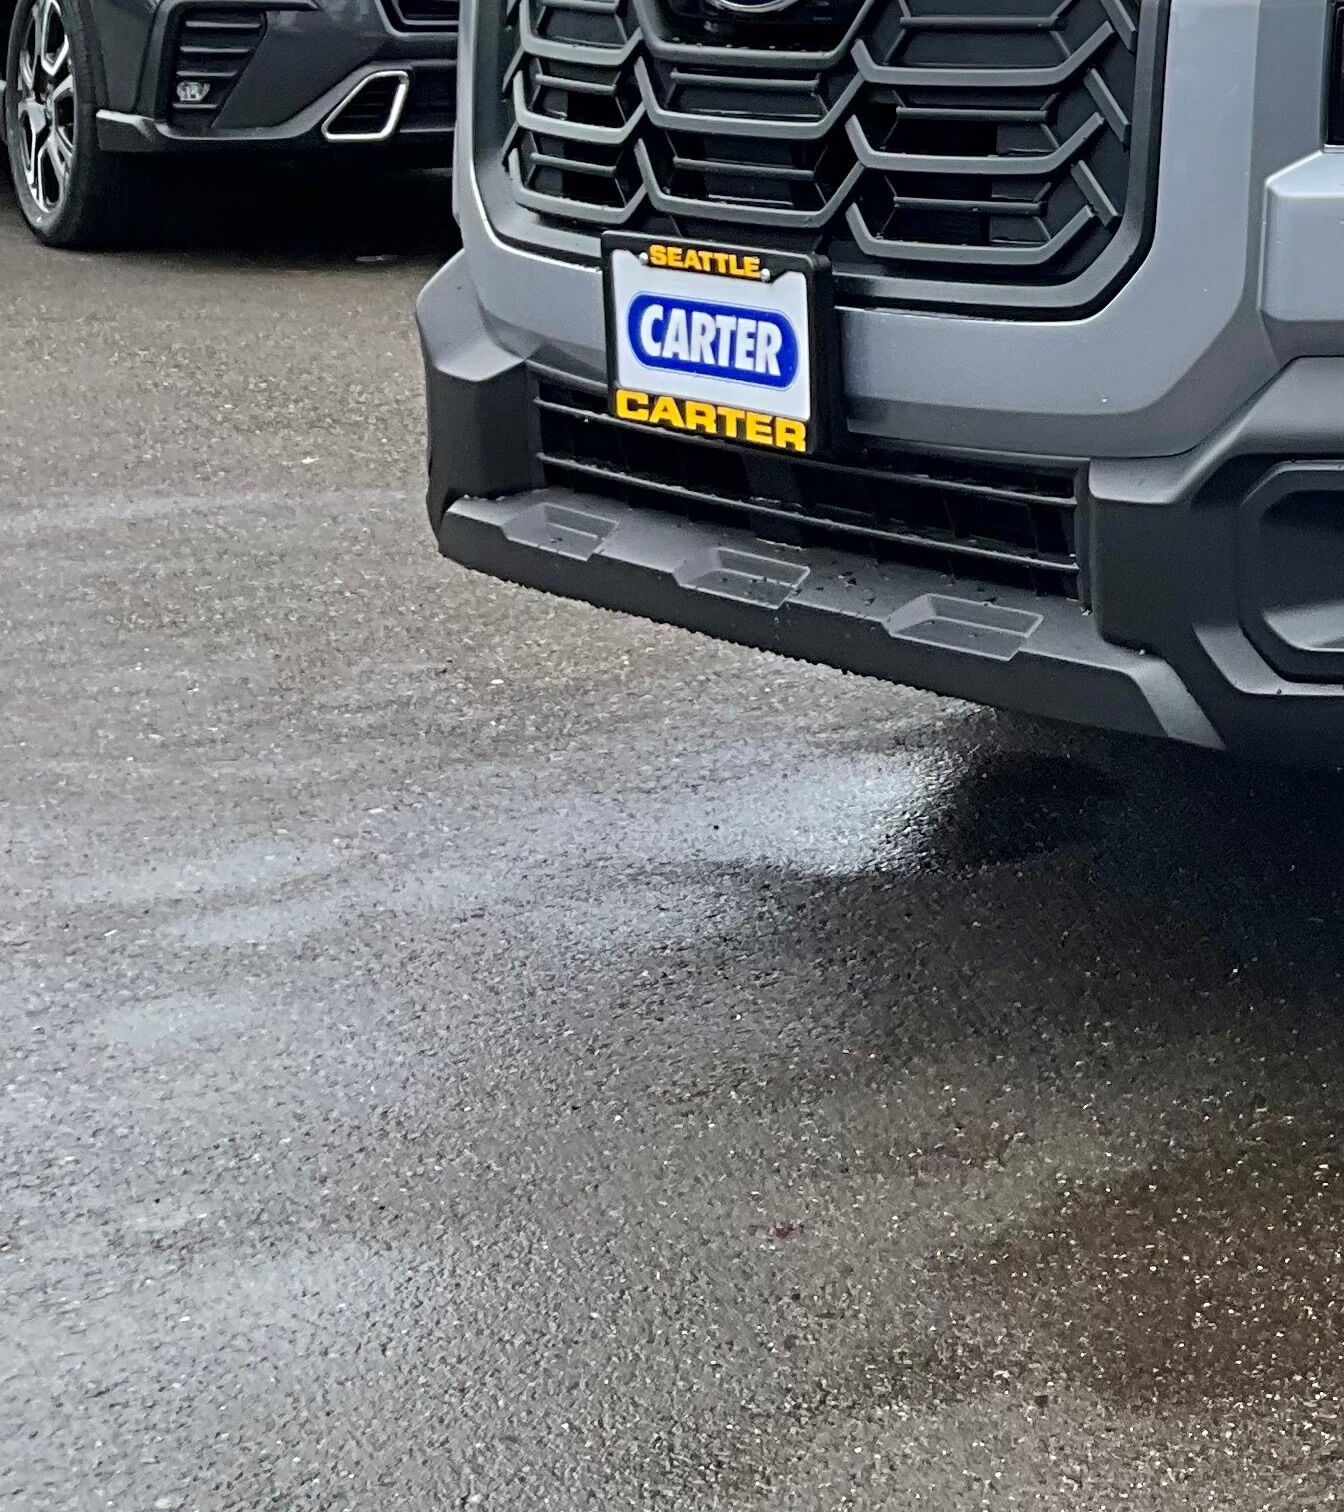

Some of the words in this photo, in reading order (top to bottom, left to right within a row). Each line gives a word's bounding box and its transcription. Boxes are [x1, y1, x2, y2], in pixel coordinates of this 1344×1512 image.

[649, 244, 761, 278] SEATTLE
[640, 304, 783, 376] CARTER
[615, 389, 807, 453] CARTER
